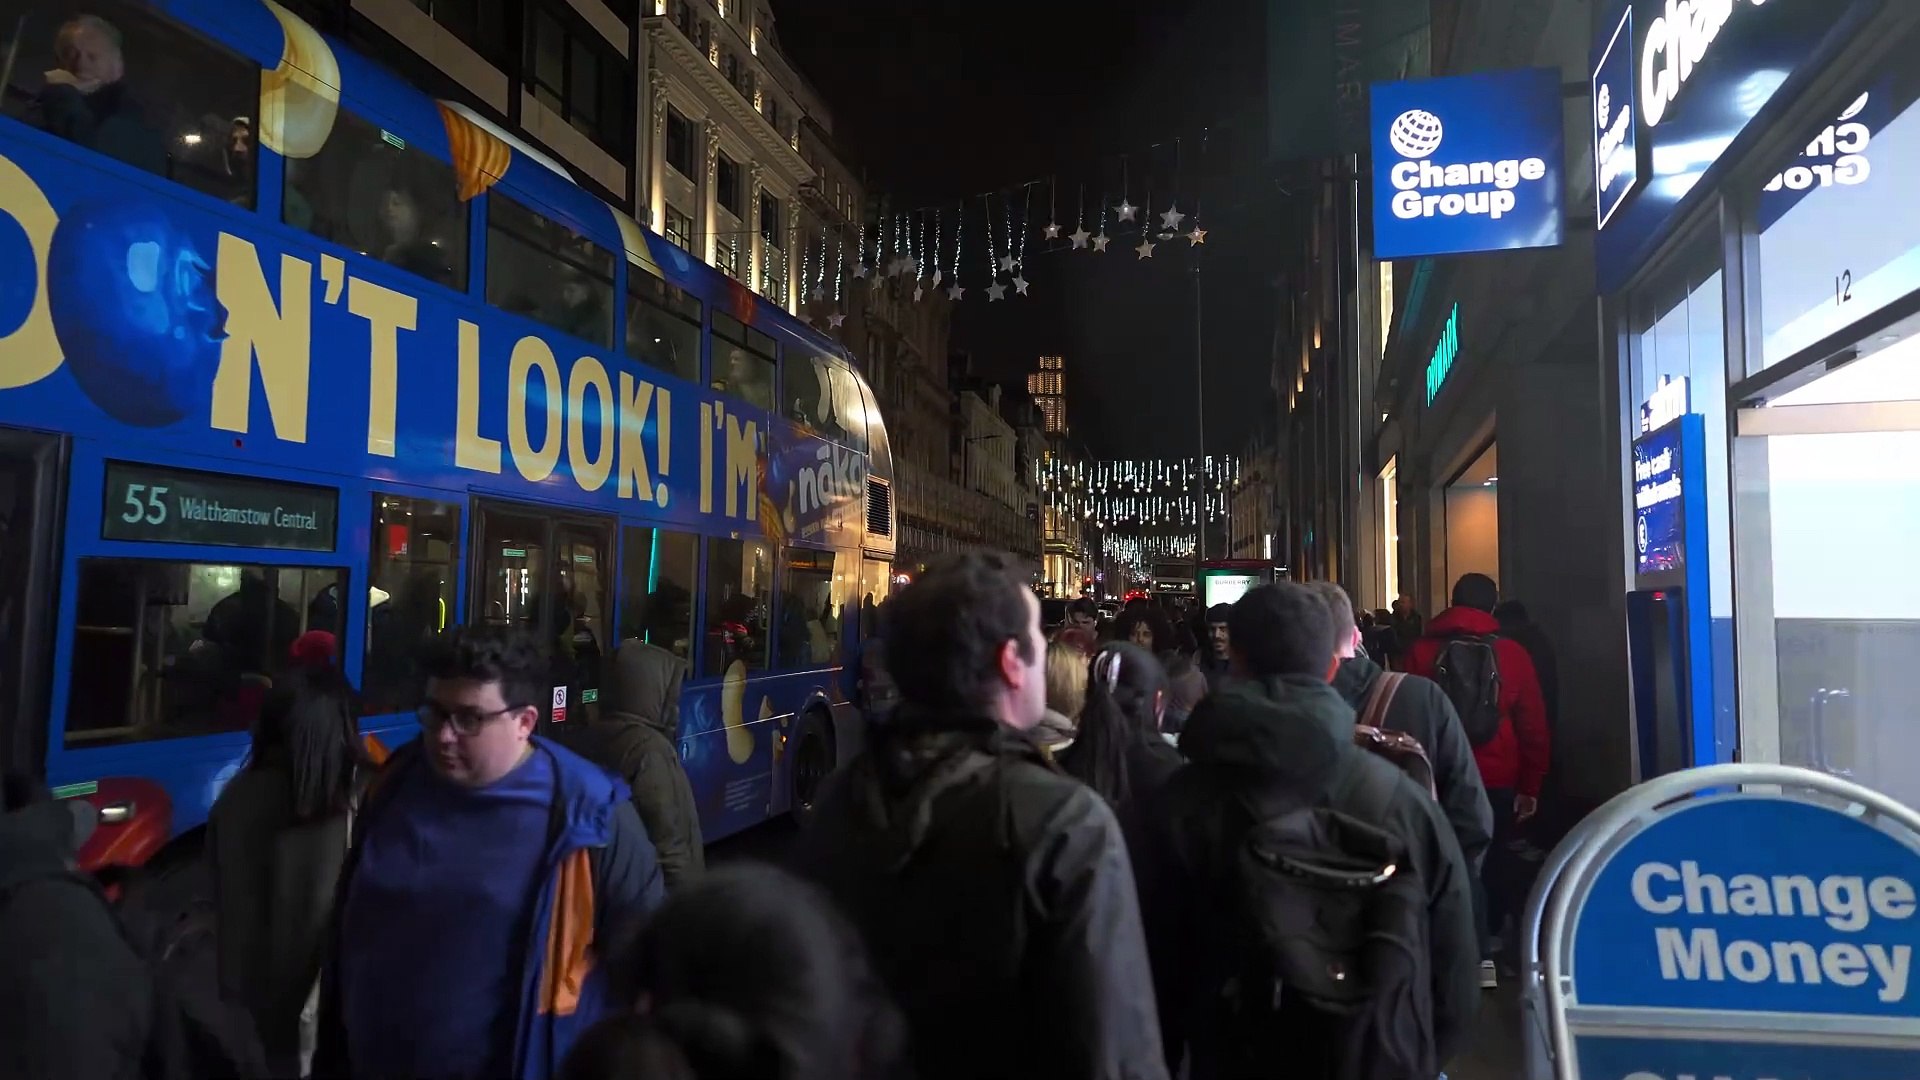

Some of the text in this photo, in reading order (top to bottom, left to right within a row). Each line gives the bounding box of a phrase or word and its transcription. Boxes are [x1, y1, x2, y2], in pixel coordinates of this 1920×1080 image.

[1391, 157, 1546, 190] Change
[1391, 188, 1516, 219] Group
[1835, 268, 1852, 306] 12
[455, 318, 671, 508] LOOK!
[700, 401, 758, 521] I'M
[122, 483, 318, 530] 55 Walthamstow Central
[1631, 860, 1917, 932] Change
[1654, 927, 1912, 1002] Money
